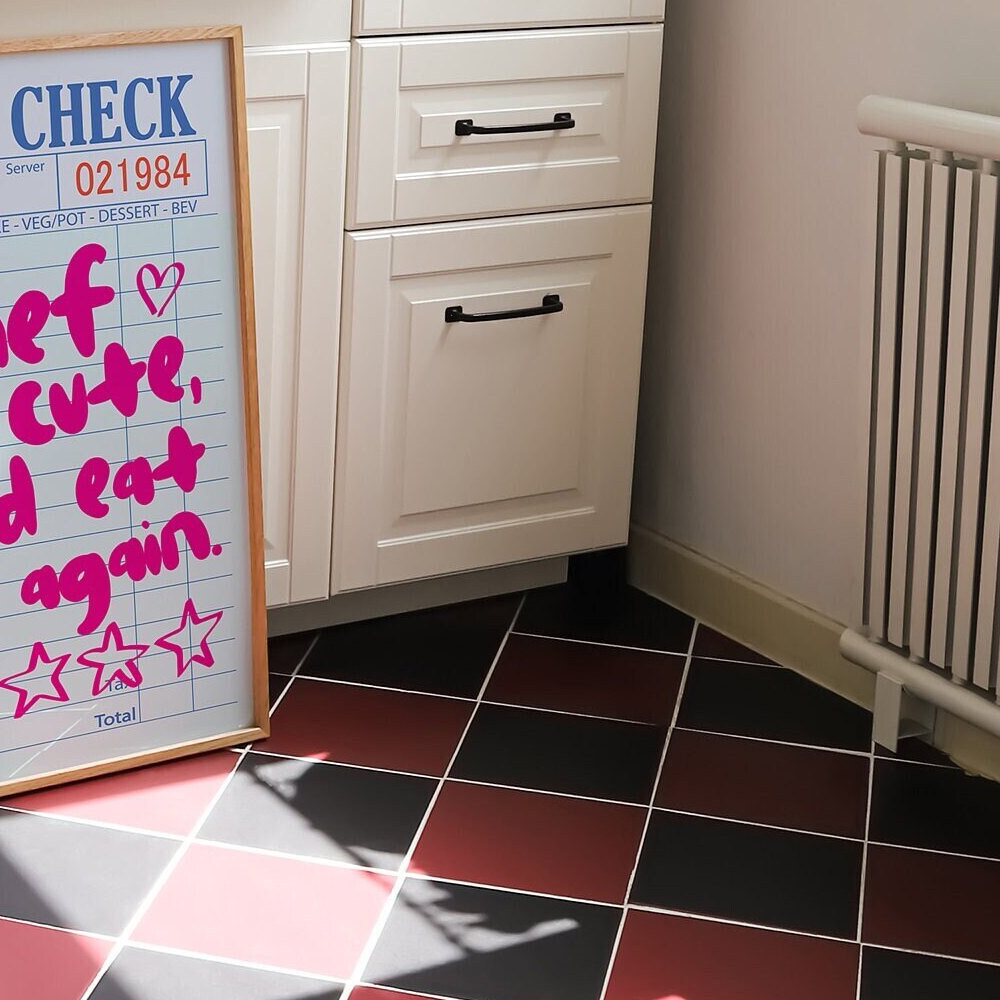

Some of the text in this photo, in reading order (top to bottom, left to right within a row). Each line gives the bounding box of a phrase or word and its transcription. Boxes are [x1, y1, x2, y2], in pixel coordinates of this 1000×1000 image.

[11, 74, 197, 151] CHECK
[6, 162, 45, 175] Server
[75, 153, 191, 196] 021984
[22, 211, 87, 231] VEG/POT
[99, 203, 160, 222] DESSERT
[172, 199, 198, 215] BEV
[8, 335, 202, 446] cute,
[75, 425, 206, 519] eat
[21, 511, 223, 636] again.
[94, 706, 137, 728] Total
